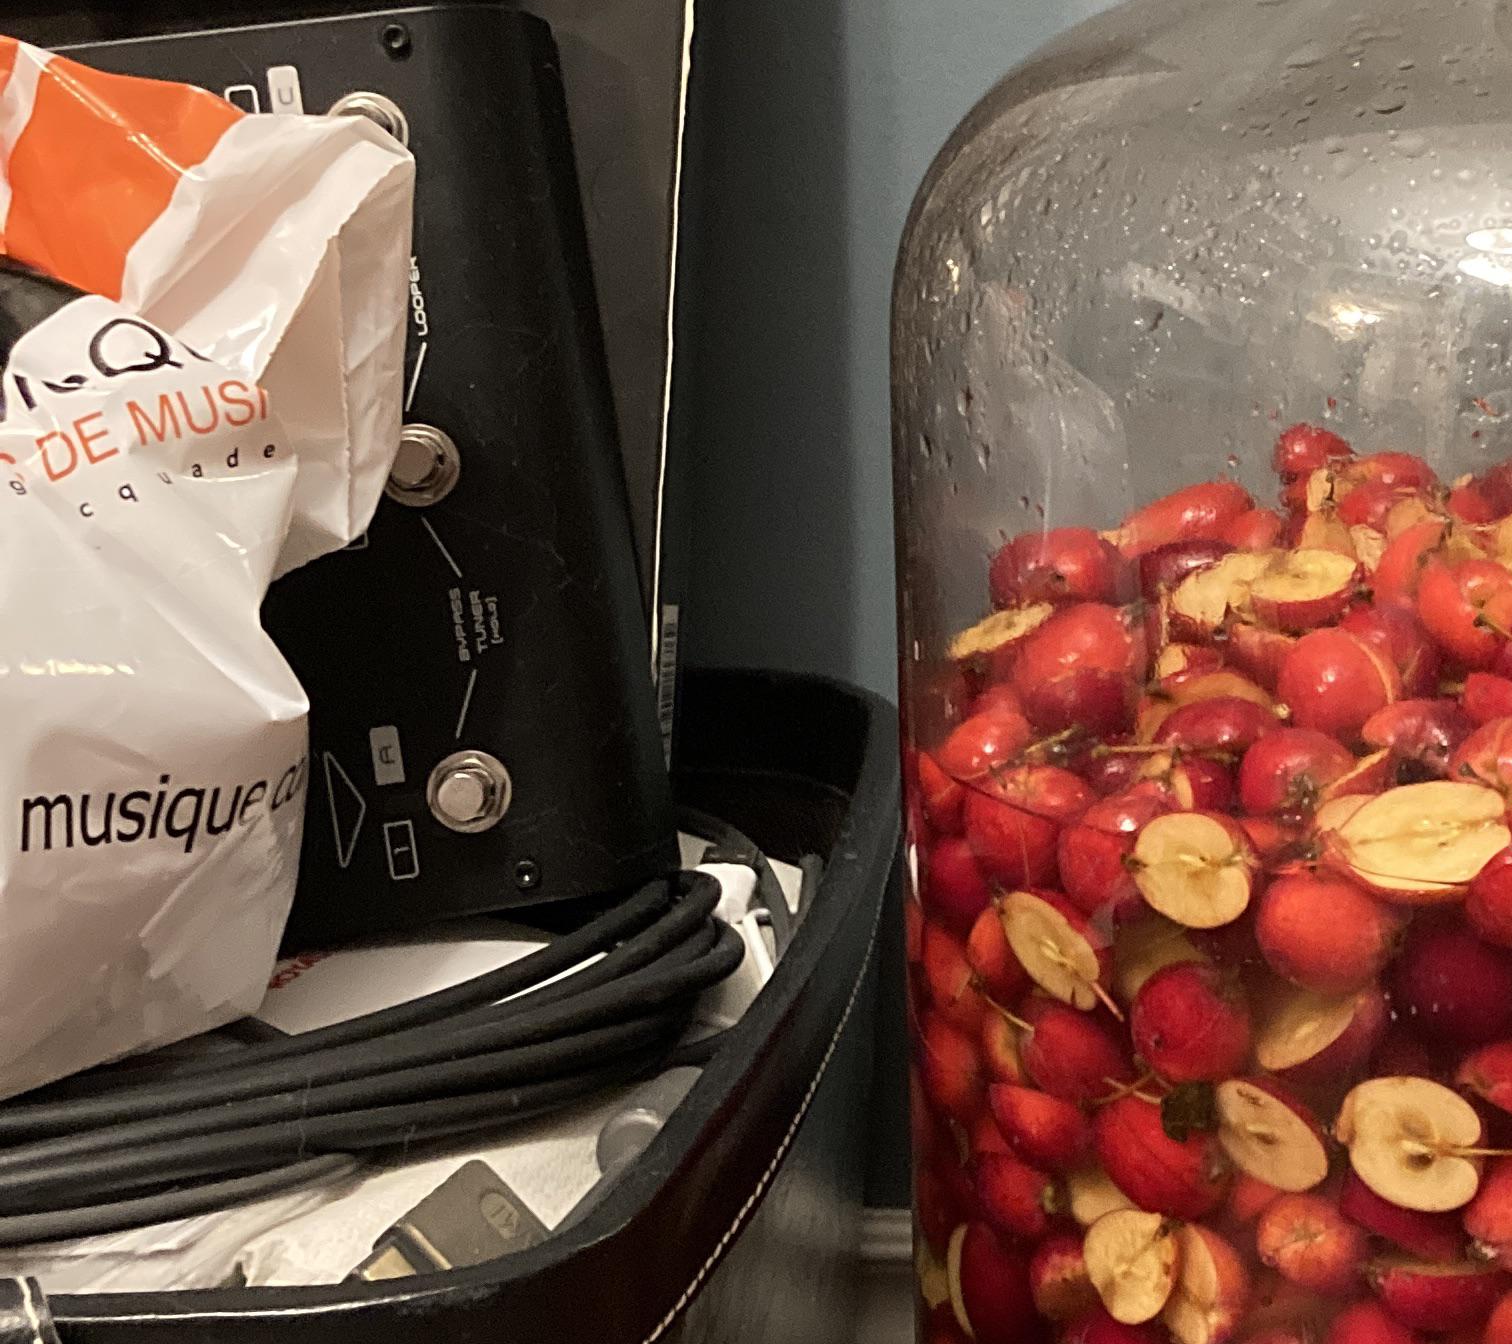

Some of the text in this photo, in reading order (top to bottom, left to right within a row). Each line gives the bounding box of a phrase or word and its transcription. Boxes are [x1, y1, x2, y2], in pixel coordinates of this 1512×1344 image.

[35, 410, 120, 483] DE
[448, 587, 472, 662] BYPASS
[469, 590, 488, 654] TUNER
